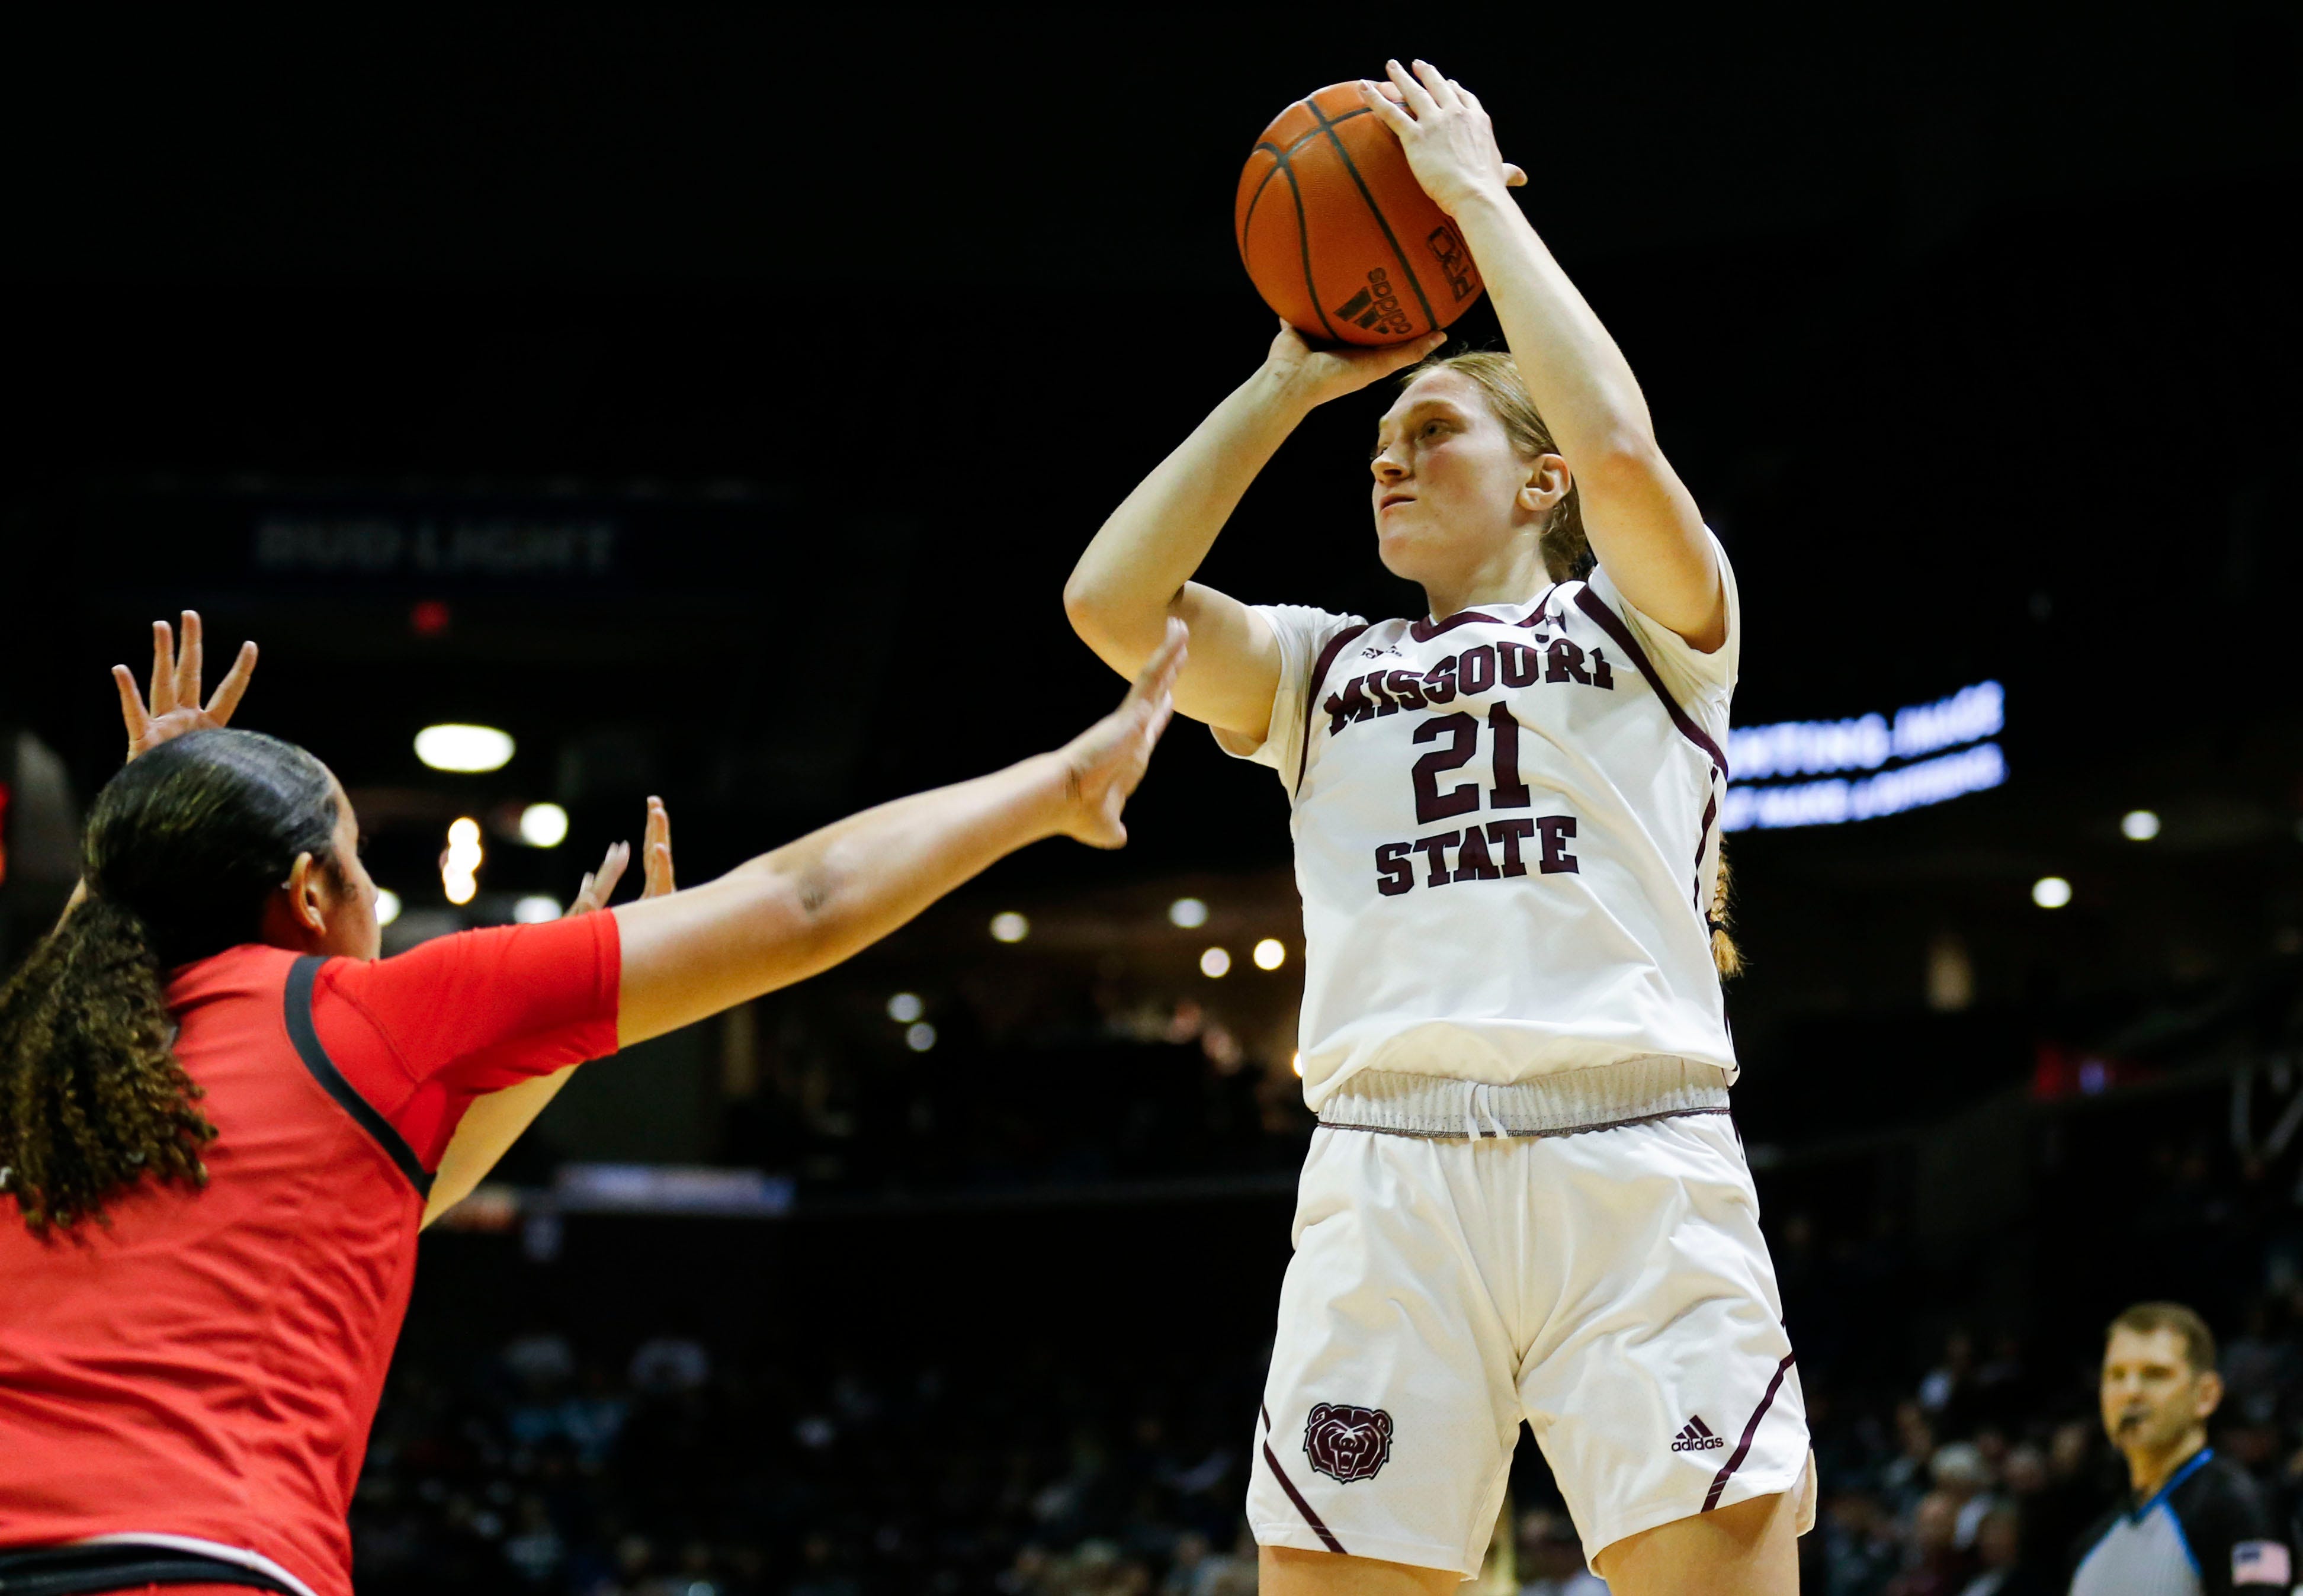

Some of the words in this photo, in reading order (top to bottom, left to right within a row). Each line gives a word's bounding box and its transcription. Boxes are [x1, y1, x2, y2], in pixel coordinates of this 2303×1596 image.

[1367, 267, 1413, 335] adidas
[1426, 226, 1476, 303] PRO
[1323, 638, 1614, 737] MISSOURI
[1412, 700, 1531, 826] 21
[1375, 815, 1580, 897] STATE
[1671, 1437, 1724, 1452] adidas
